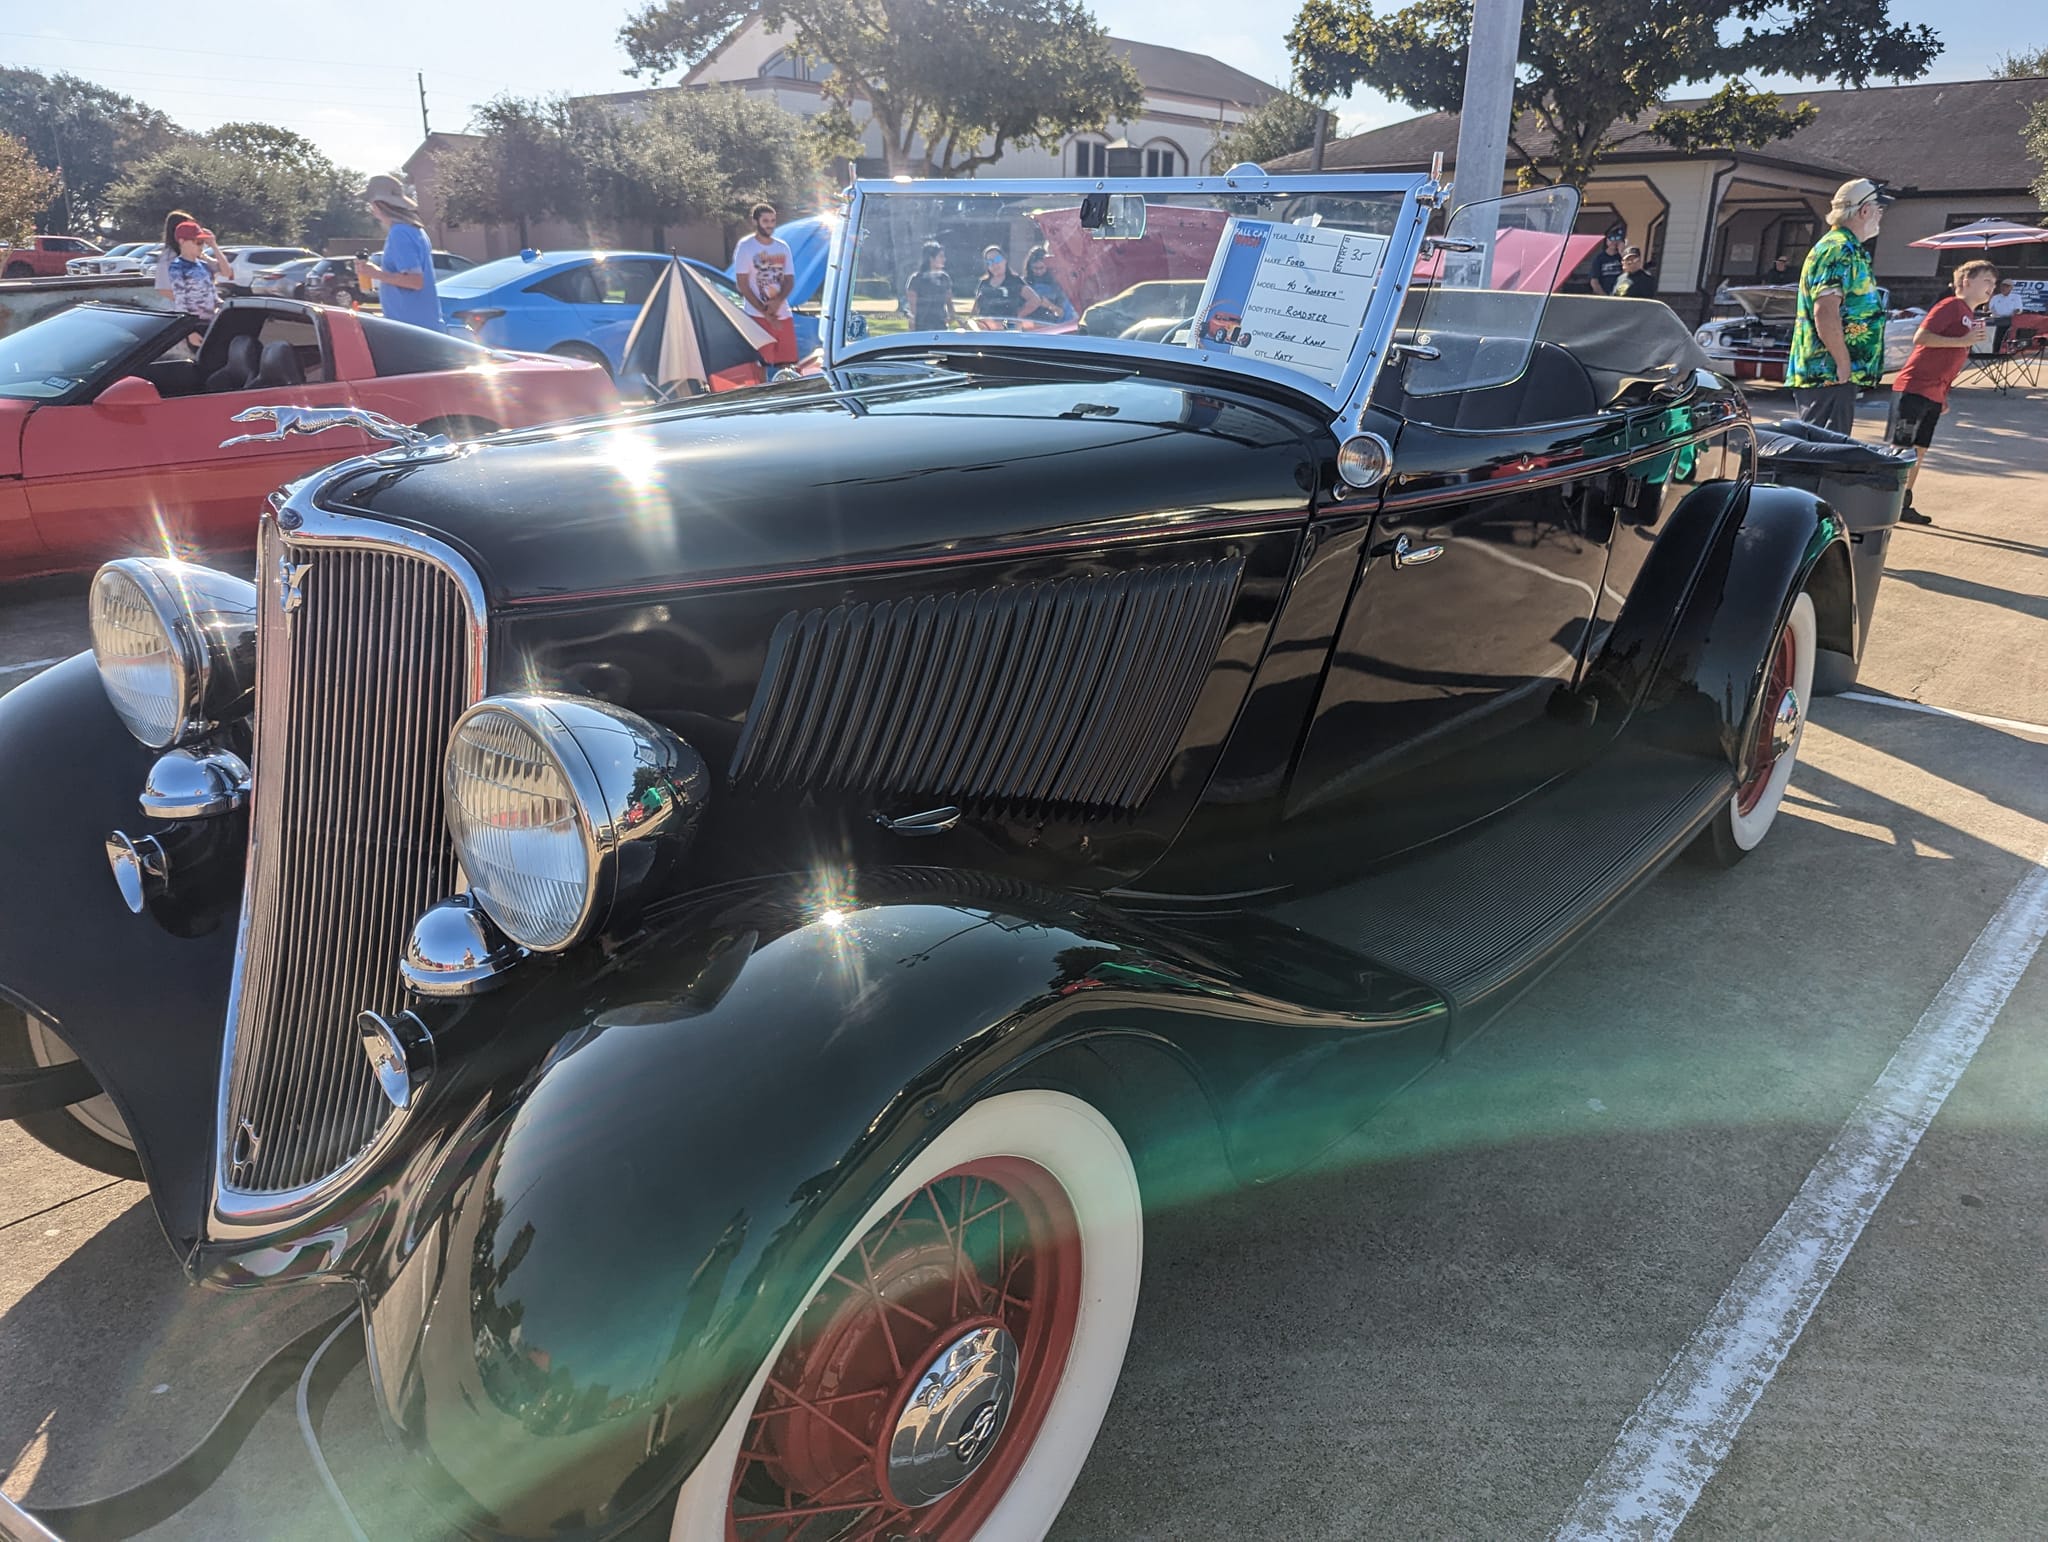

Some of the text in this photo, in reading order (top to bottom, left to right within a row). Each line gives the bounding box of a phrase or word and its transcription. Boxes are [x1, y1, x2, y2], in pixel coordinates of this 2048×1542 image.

[1294, 232, 1315, 244] 1933
[1333, 245, 1348, 273] ENTRY
[1350, 248, 1372, 261] 35
[1256, 281, 1276, 289] MODEL
[1264, 307, 1281, 315] STYLE
[1251, 329, 1273, 338] OWNER
